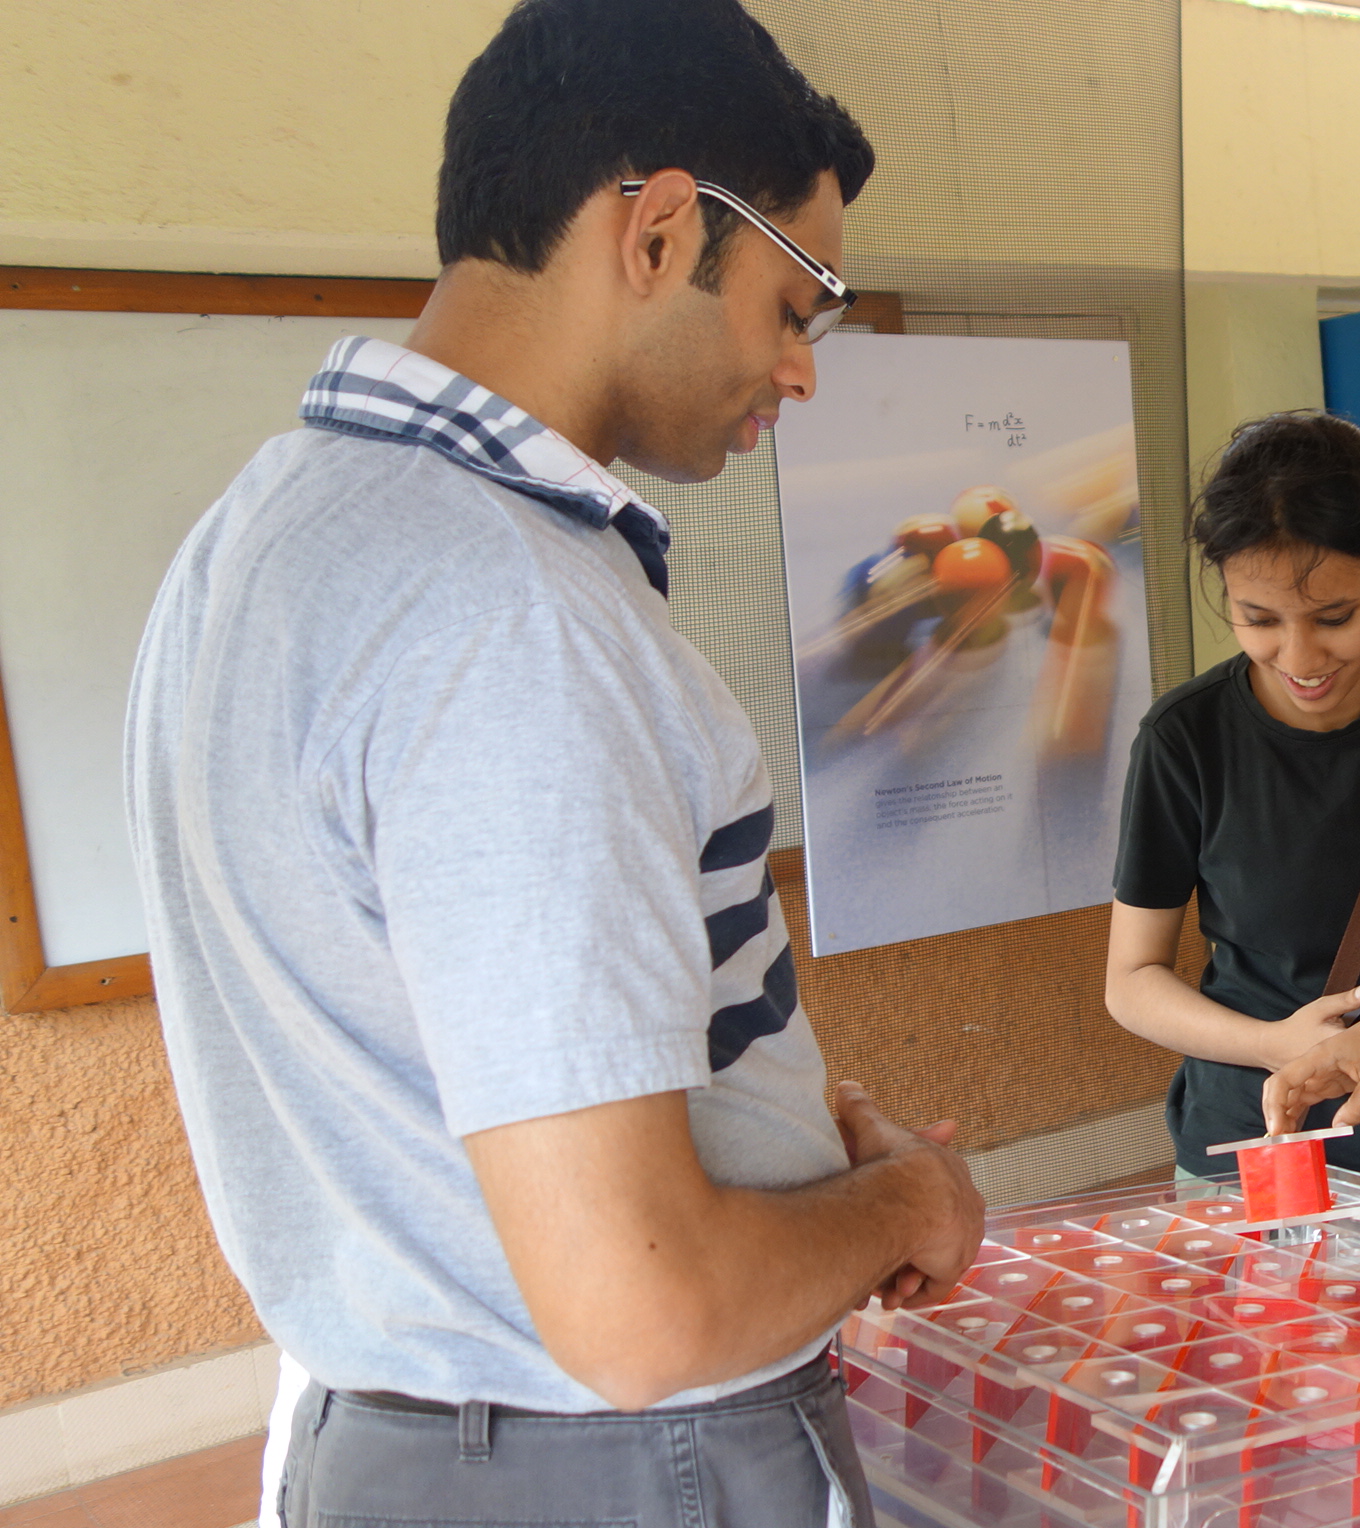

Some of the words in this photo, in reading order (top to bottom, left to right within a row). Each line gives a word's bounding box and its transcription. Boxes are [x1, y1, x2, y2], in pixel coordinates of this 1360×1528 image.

[965, 414, 974, 431] F
[875, 785, 912, 796] Newton's
[915, 780, 944, 791] Second
[947, 779, 962, 787] Law
[965, 776, 973, 784] of
[975, 774, 1002, 783] Motion
[899, 796, 912, 804] the
[959, 786, 992, 796] between
[876, 809, 908, 819] object's
[933, 802, 946, 810] the
[949, 800, 968, 808] force
[970, 796, 993, 805] acting
[877, 820, 892, 829] and
[894, 819, 908, 827] the
[910, 812, 955, 825] consequent
